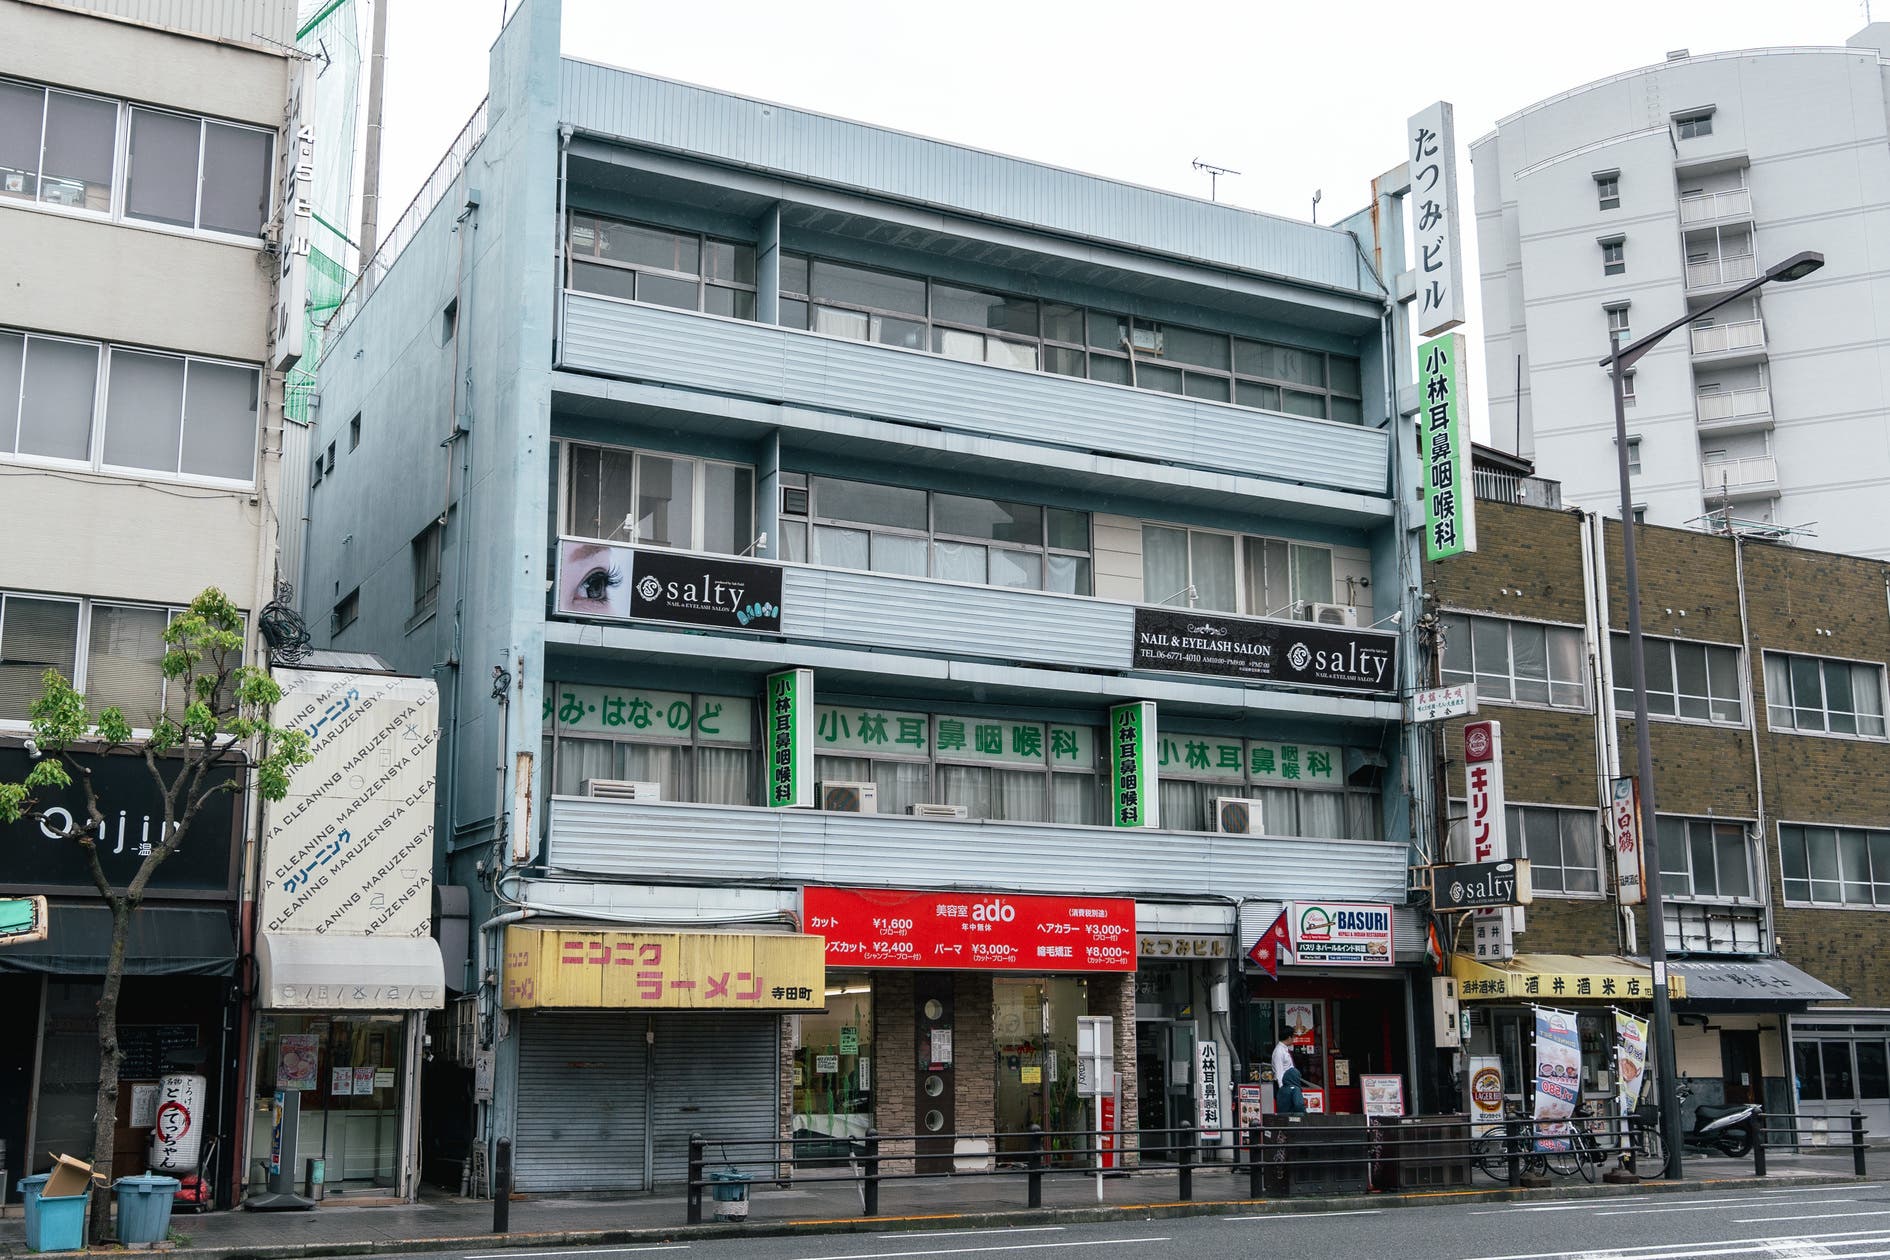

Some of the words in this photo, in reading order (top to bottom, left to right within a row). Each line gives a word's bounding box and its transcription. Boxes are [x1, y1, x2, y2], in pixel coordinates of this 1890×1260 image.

[1413, 127, 1446, 315] たつみビル
[1425, 345, 1457, 552] 小林耳鼻咽喉科
[666, 574, 745, 613] salty
[1141, 633, 1169, 646] NAIL
[1171, 636, 1180, 647] &
[1182, 637, 1232, 652] EYELASH
[1234, 643, 1271, 656] SALON
[1315, 641, 1388, 683] salty
[302, 687, 360, 744] リーニング
[312, 690, 385, 755] MARUZENSYA
[775, 679, 791, 802] 小林耳鼻咽喉科
[818, 710, 1079, 760] 小林耳鼻咽喉科
[283, 772, 342, 826] CLEANING
[343, 707, 416, 773] MARUZENSYA
[1119, 710, 1138, 823] 小林耳鼻咽喉科
[275, 824, 335, 879] CLEANING
[336, 757, 410, 824] MARUZENSYA
[268, 875, 329, 931] CLEANING
[330, 807, 406, 876] MARUZENSYA
[283, 828, 351, 893] クリーニング
[362, 824, 435, 893] MARUZENSYA
[1466, 872, 1514, 901] salty
[811, 917, 838, 928] カット
[873, 918, 912, 930] ¥1,600
[936, 904, 968, 917] 美容室
[972, 899, 1015, 922] ado
[1338, 911, 1388, 931] BASURI
[961, 923, 992, 932] 年中無休
[1037, 923, 1080, 933] ヘアカラー
[1477, 926, 1499, 938] 酒井
[562, 941, 662, 966] ニンニク
[873, 942, 913, 953] ¥2,400
[934, 944, 962, 955] パーマ
[1036, 946, 1073, 957] 縮毛矯正
[1141, 937, 1224, 956] たつみビル
[1478, 944, 1499, 956] 酒店
[636, 971, 763, 1000] ラーメン
[772, 987, 812, 1001] 寺田町
[1462, 979, 1505, 995] 酒井酒米店
[1525, 976, 1641, 996] 酒井酒米店
